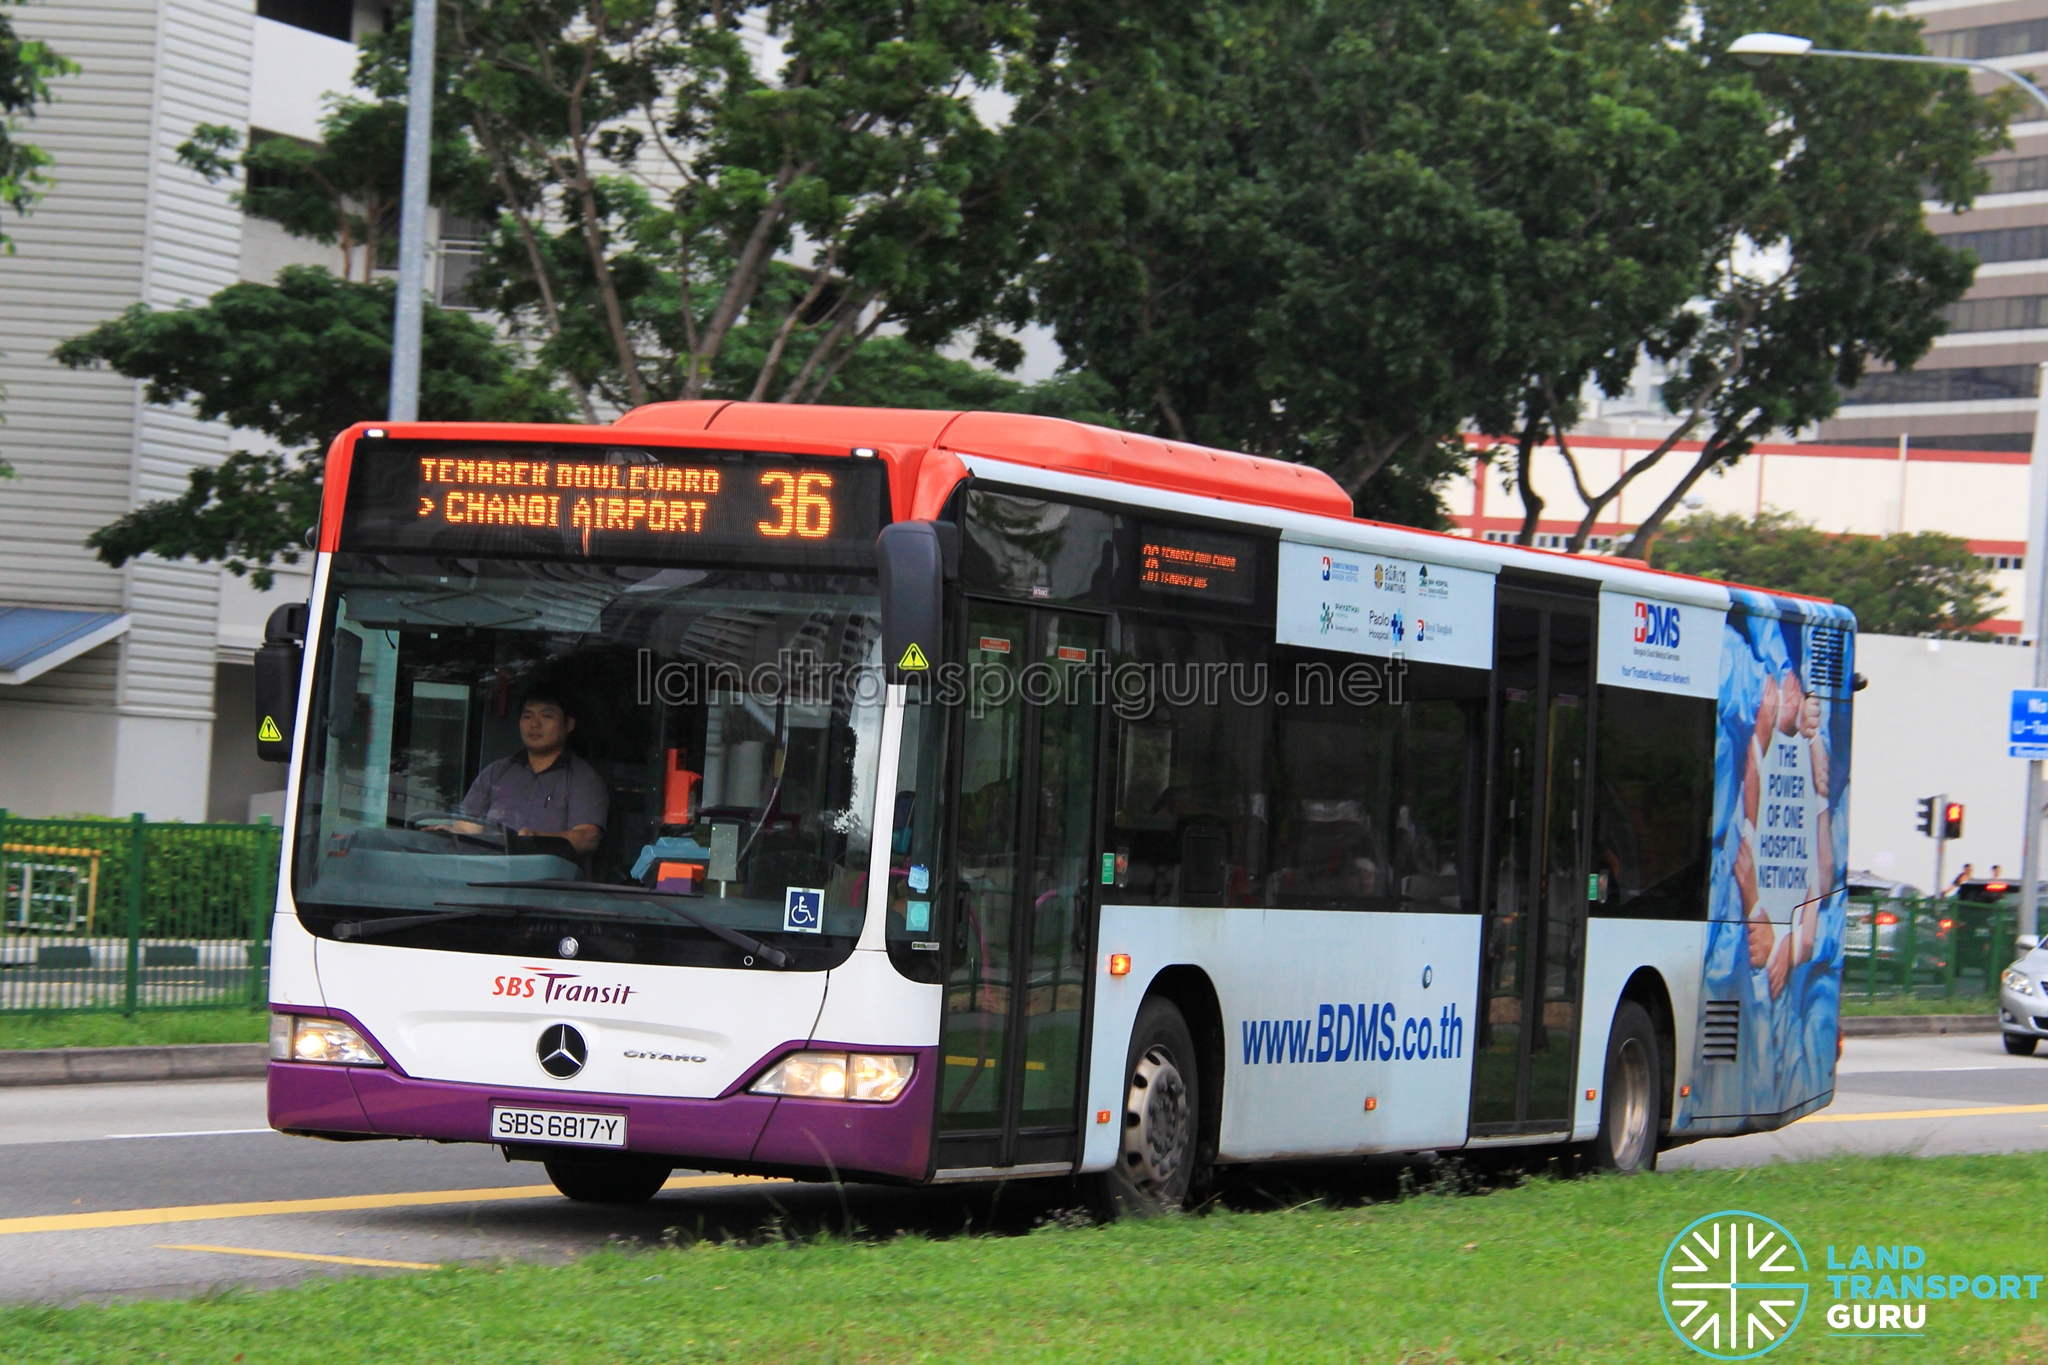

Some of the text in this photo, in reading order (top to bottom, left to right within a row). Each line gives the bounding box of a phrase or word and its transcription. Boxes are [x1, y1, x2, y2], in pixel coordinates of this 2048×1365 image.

[421, 458, 548, 487] TEMASEK
[446, 491, 707, 533] CHANGI AIRPORT
[757, 470, 833, 538] 36
[1369, 609, 1390, 627] Paolo
[1635, 602, 1680, 648] BDMS
[1778, 744, 1798, 768] THE
[1768, 773, 1805, 799] POWER
[1767, 804, 1804, 829] OF ONE
[1760, 834, 1809, 860] HOSPITAL
[1758, 865, 1809, 890] NETWORK
[492, 972, 640, 1005] SBS Transit
[1242, 1002, 1463, 1065] www.BDMS.co.th
